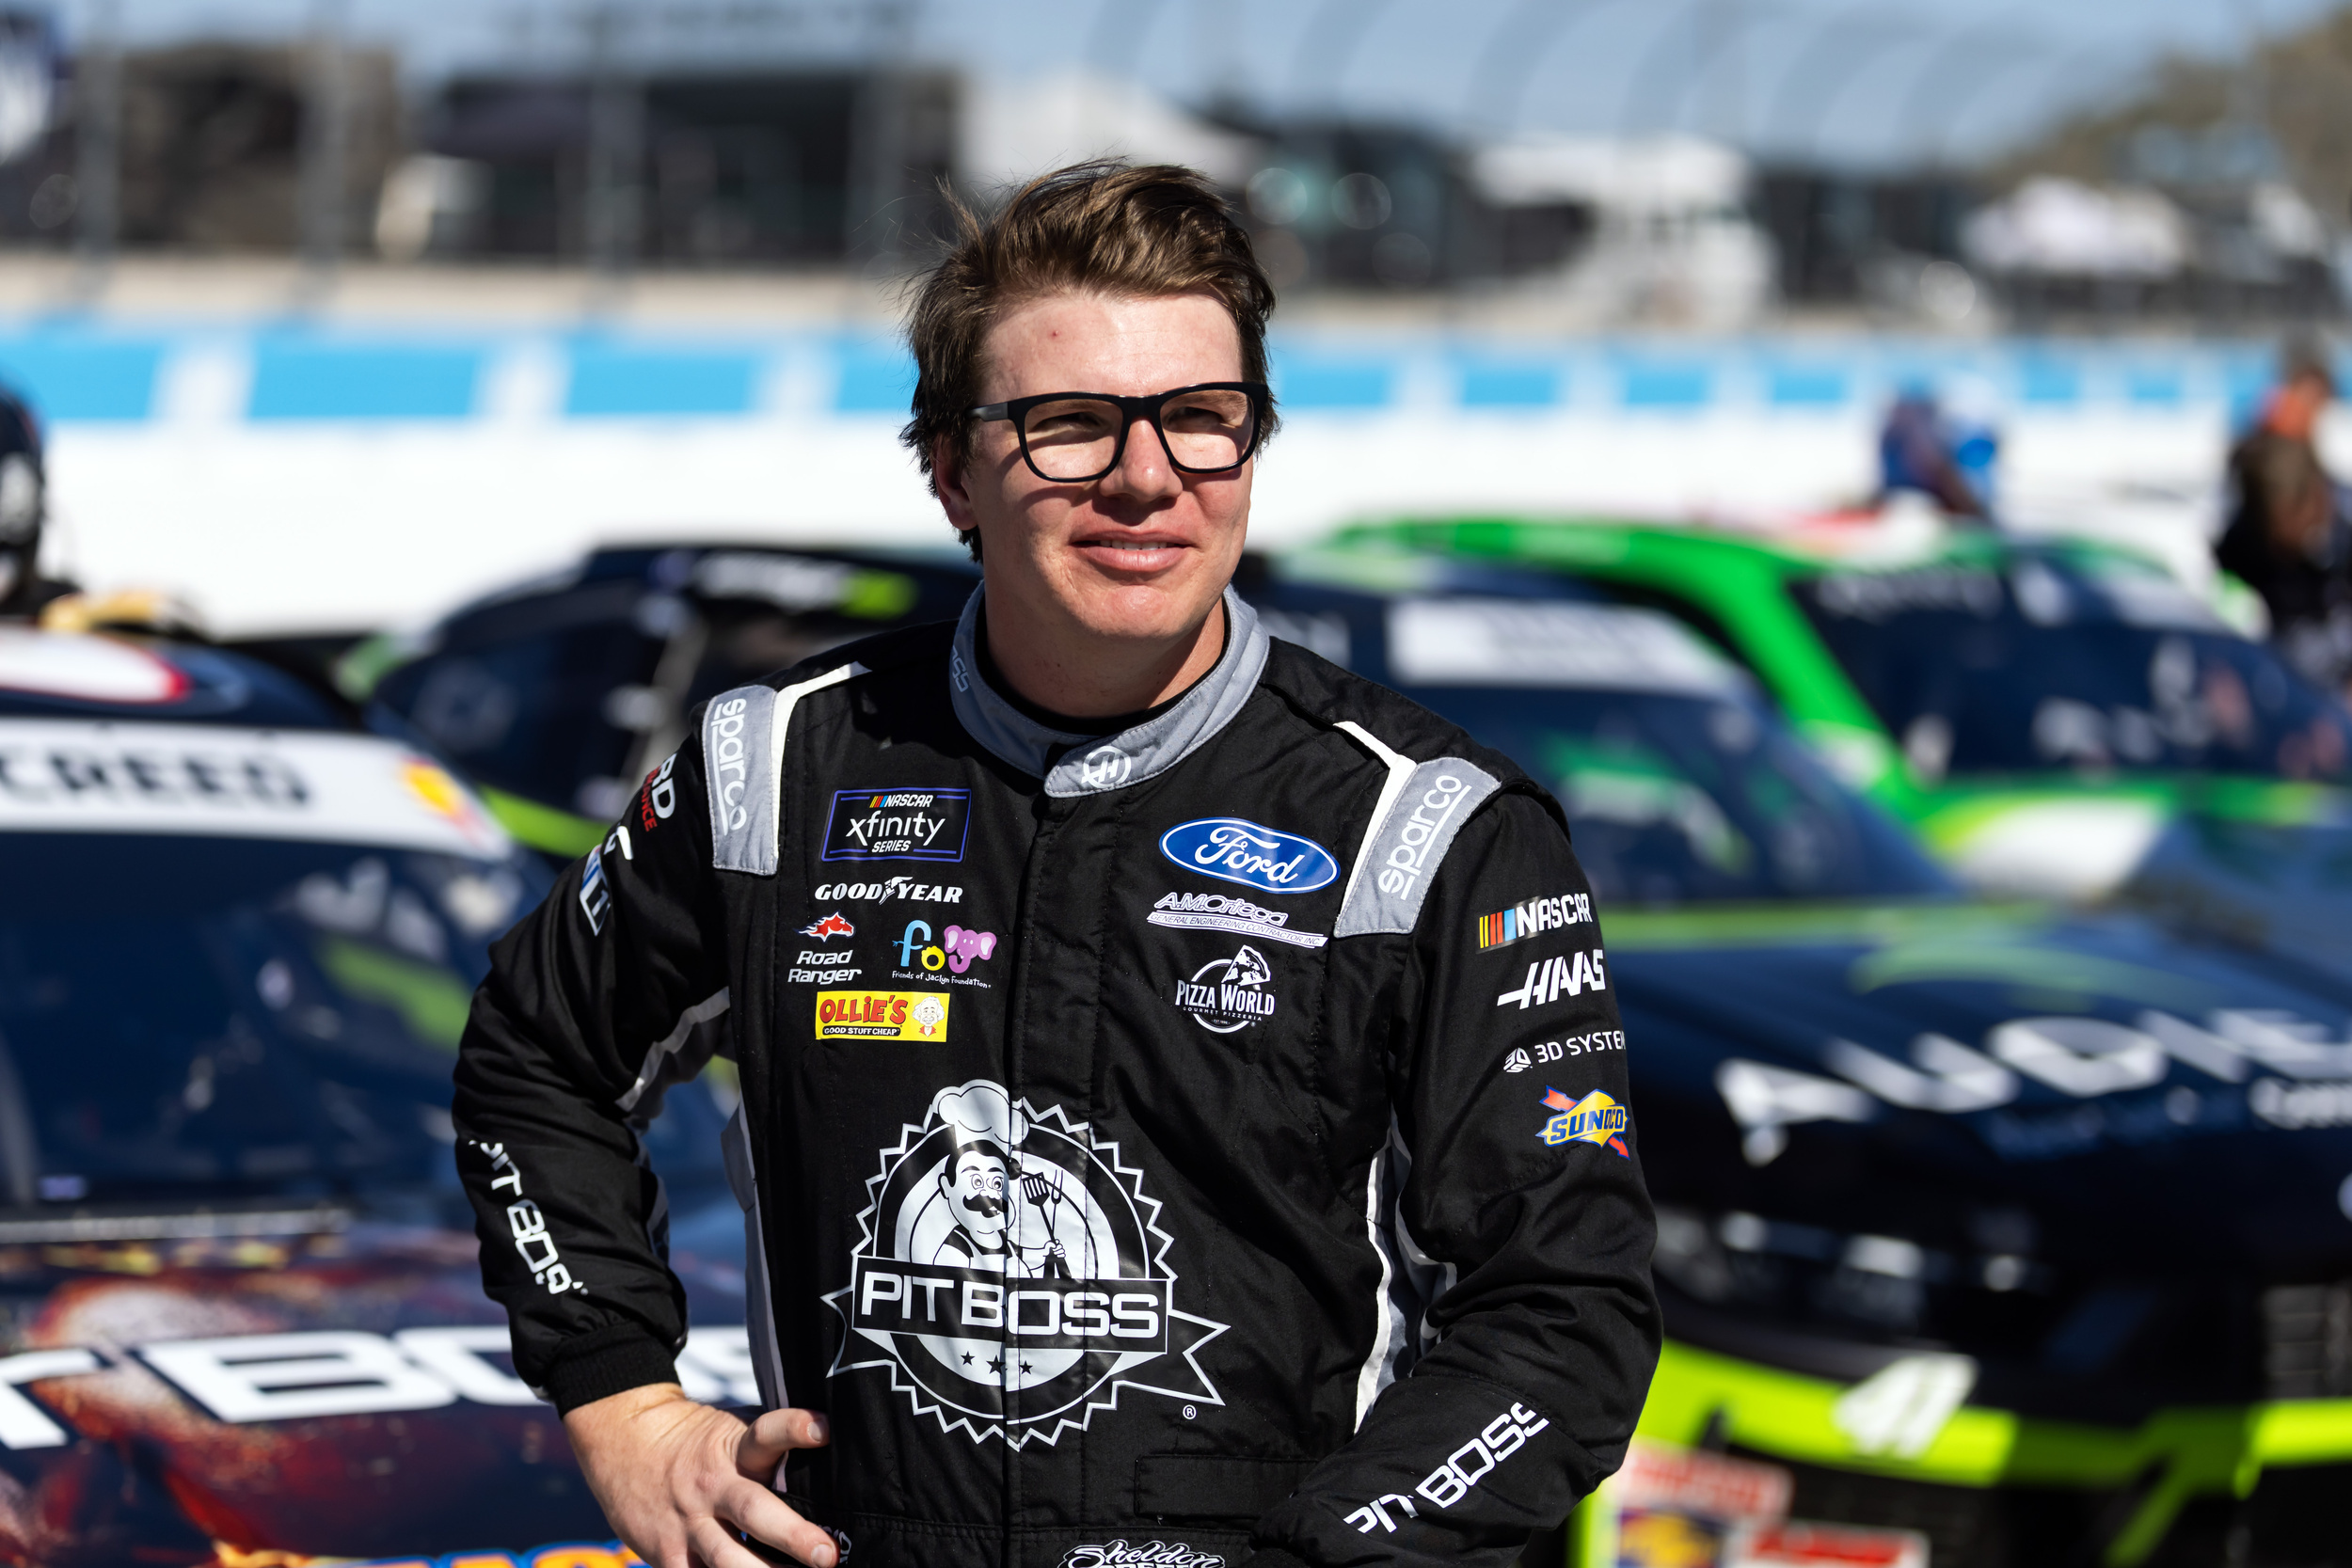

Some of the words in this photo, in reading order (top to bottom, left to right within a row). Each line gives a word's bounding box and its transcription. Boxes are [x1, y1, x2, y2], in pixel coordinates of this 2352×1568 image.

[711, 698, 747, 833] sparco
[884, 794, 933, 807] NASCAR
[846, 810, 946, 847] xfinity
[1378, 775, 1462, 895] sparco
[871, 840, 911, 853] SERIES
[1194, 826, 1306, 884] Ford
[1150, 912, 1188, 925] GENERAL
[1191, 915, 1246, 930] ENGINEERING
[1246, 923, 1303, 943] CONTRACTOR
[1304, 936, 1320, 945] INC.
[1517, 893, 1593, 938] NASCAR
[797, 950, 853, 965] Road
[787, 969, 862, 985] Ranger
[892, 971, 914, 979] Friends
[915, 972, 925, 980] of
[1497, 949, 1606, 1009] HAAS
[1183, 1006, 1219, 1015] GOURMET
[1223, 1011, 1263, 1022] PIZZERIA
[848, 1027, 872, 1036] STUFF
[1534, 1041, 1564, 1064] 3D
[1551, 1106, 1624, 1141] SUNOCO
[861, 1271, 955, 1322] PIT
[961, 1280, 1160, 1338] BOSS
[1415, 1402, 1550, 1509] BOSS
